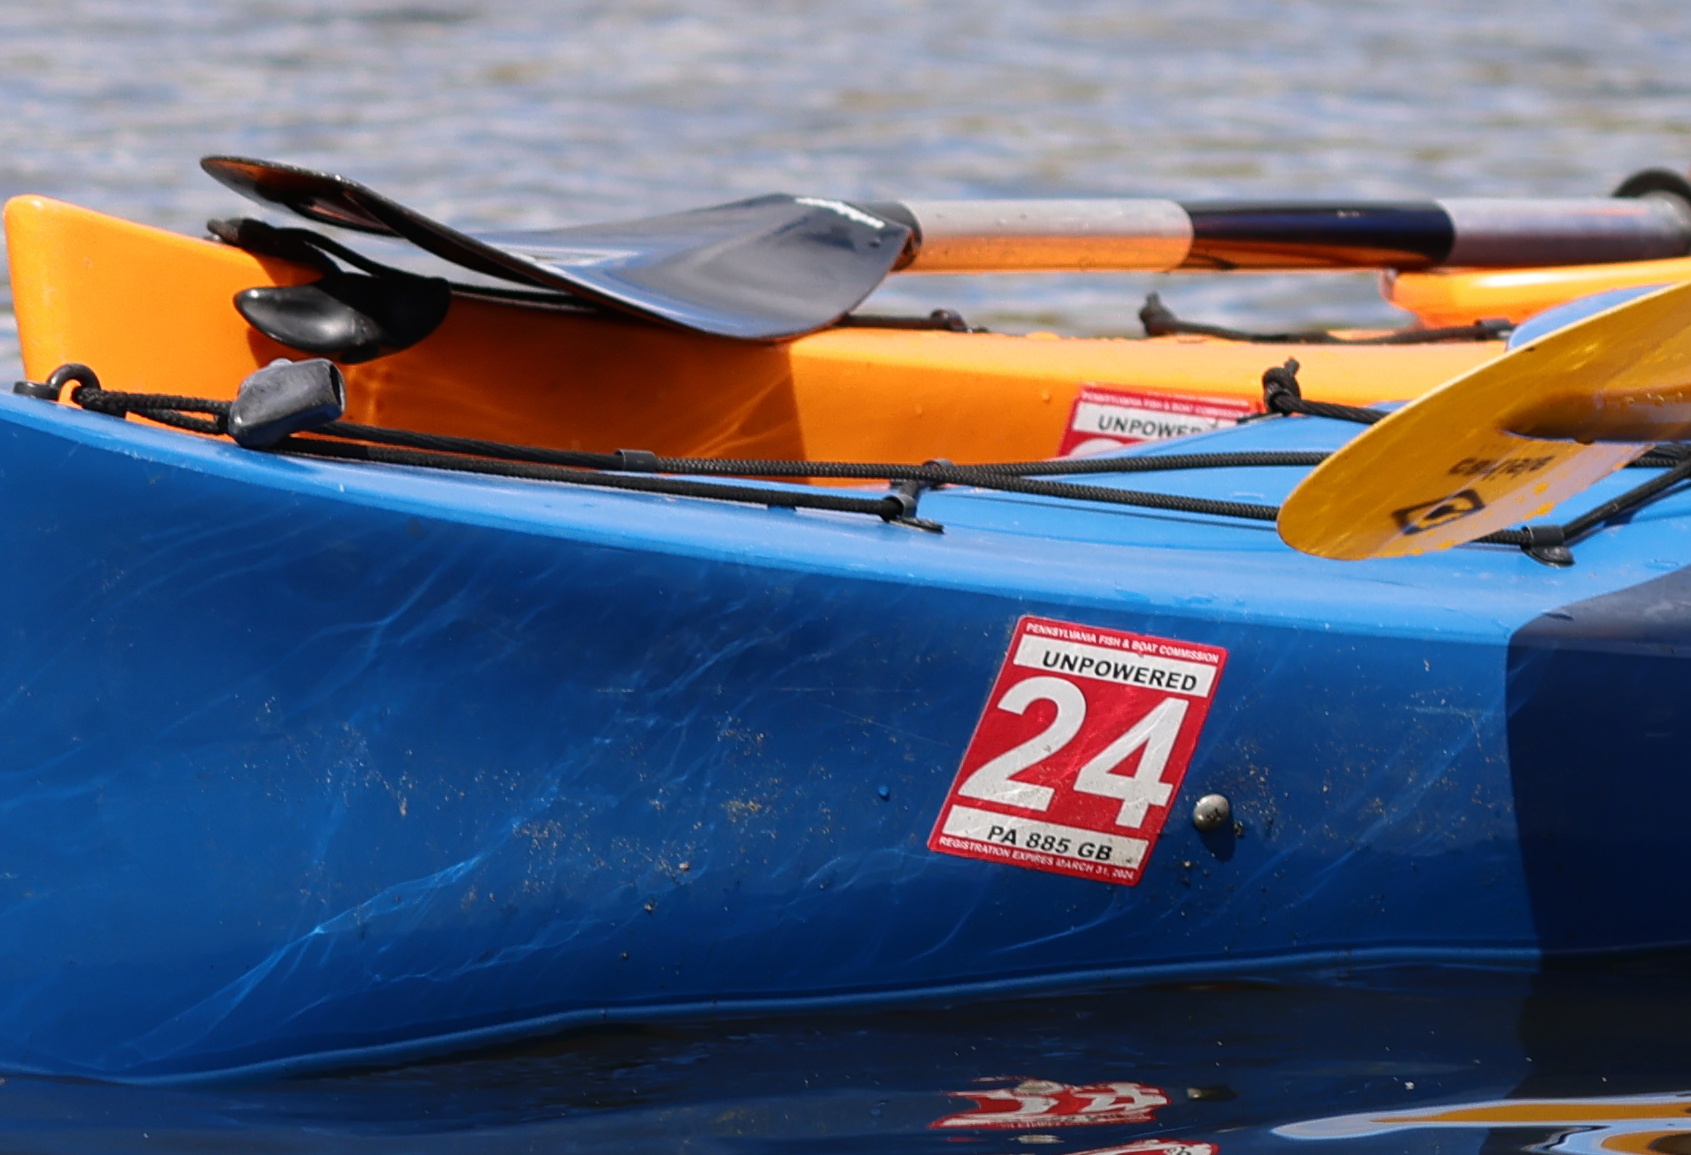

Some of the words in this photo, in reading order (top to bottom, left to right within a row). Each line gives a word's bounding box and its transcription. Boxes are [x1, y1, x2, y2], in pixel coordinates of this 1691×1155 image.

[1026, 622, 1097, 644] PENNSYLVANIA
[1099, 635, 1122, 649] FISH
[1122, 640, 1130, 649] &
[1131, 640, 1158, 653] BOAT
[1159, 644, 1219, 663] COMMISSION
[1042, 650, 1197, 692] UNPOWERED
[957, 675, 1189, 829] 24
[939, 836, 1010, 859] REGISTRATION
[1012, 850, 1053, 866] EXPIRES
[1055, 857, 1094, 873] MARCH
[987, 825, 1017, 845] PA
[1025, 832, 1072, 854] 885
[1077, 842, 1113, 861] GB
